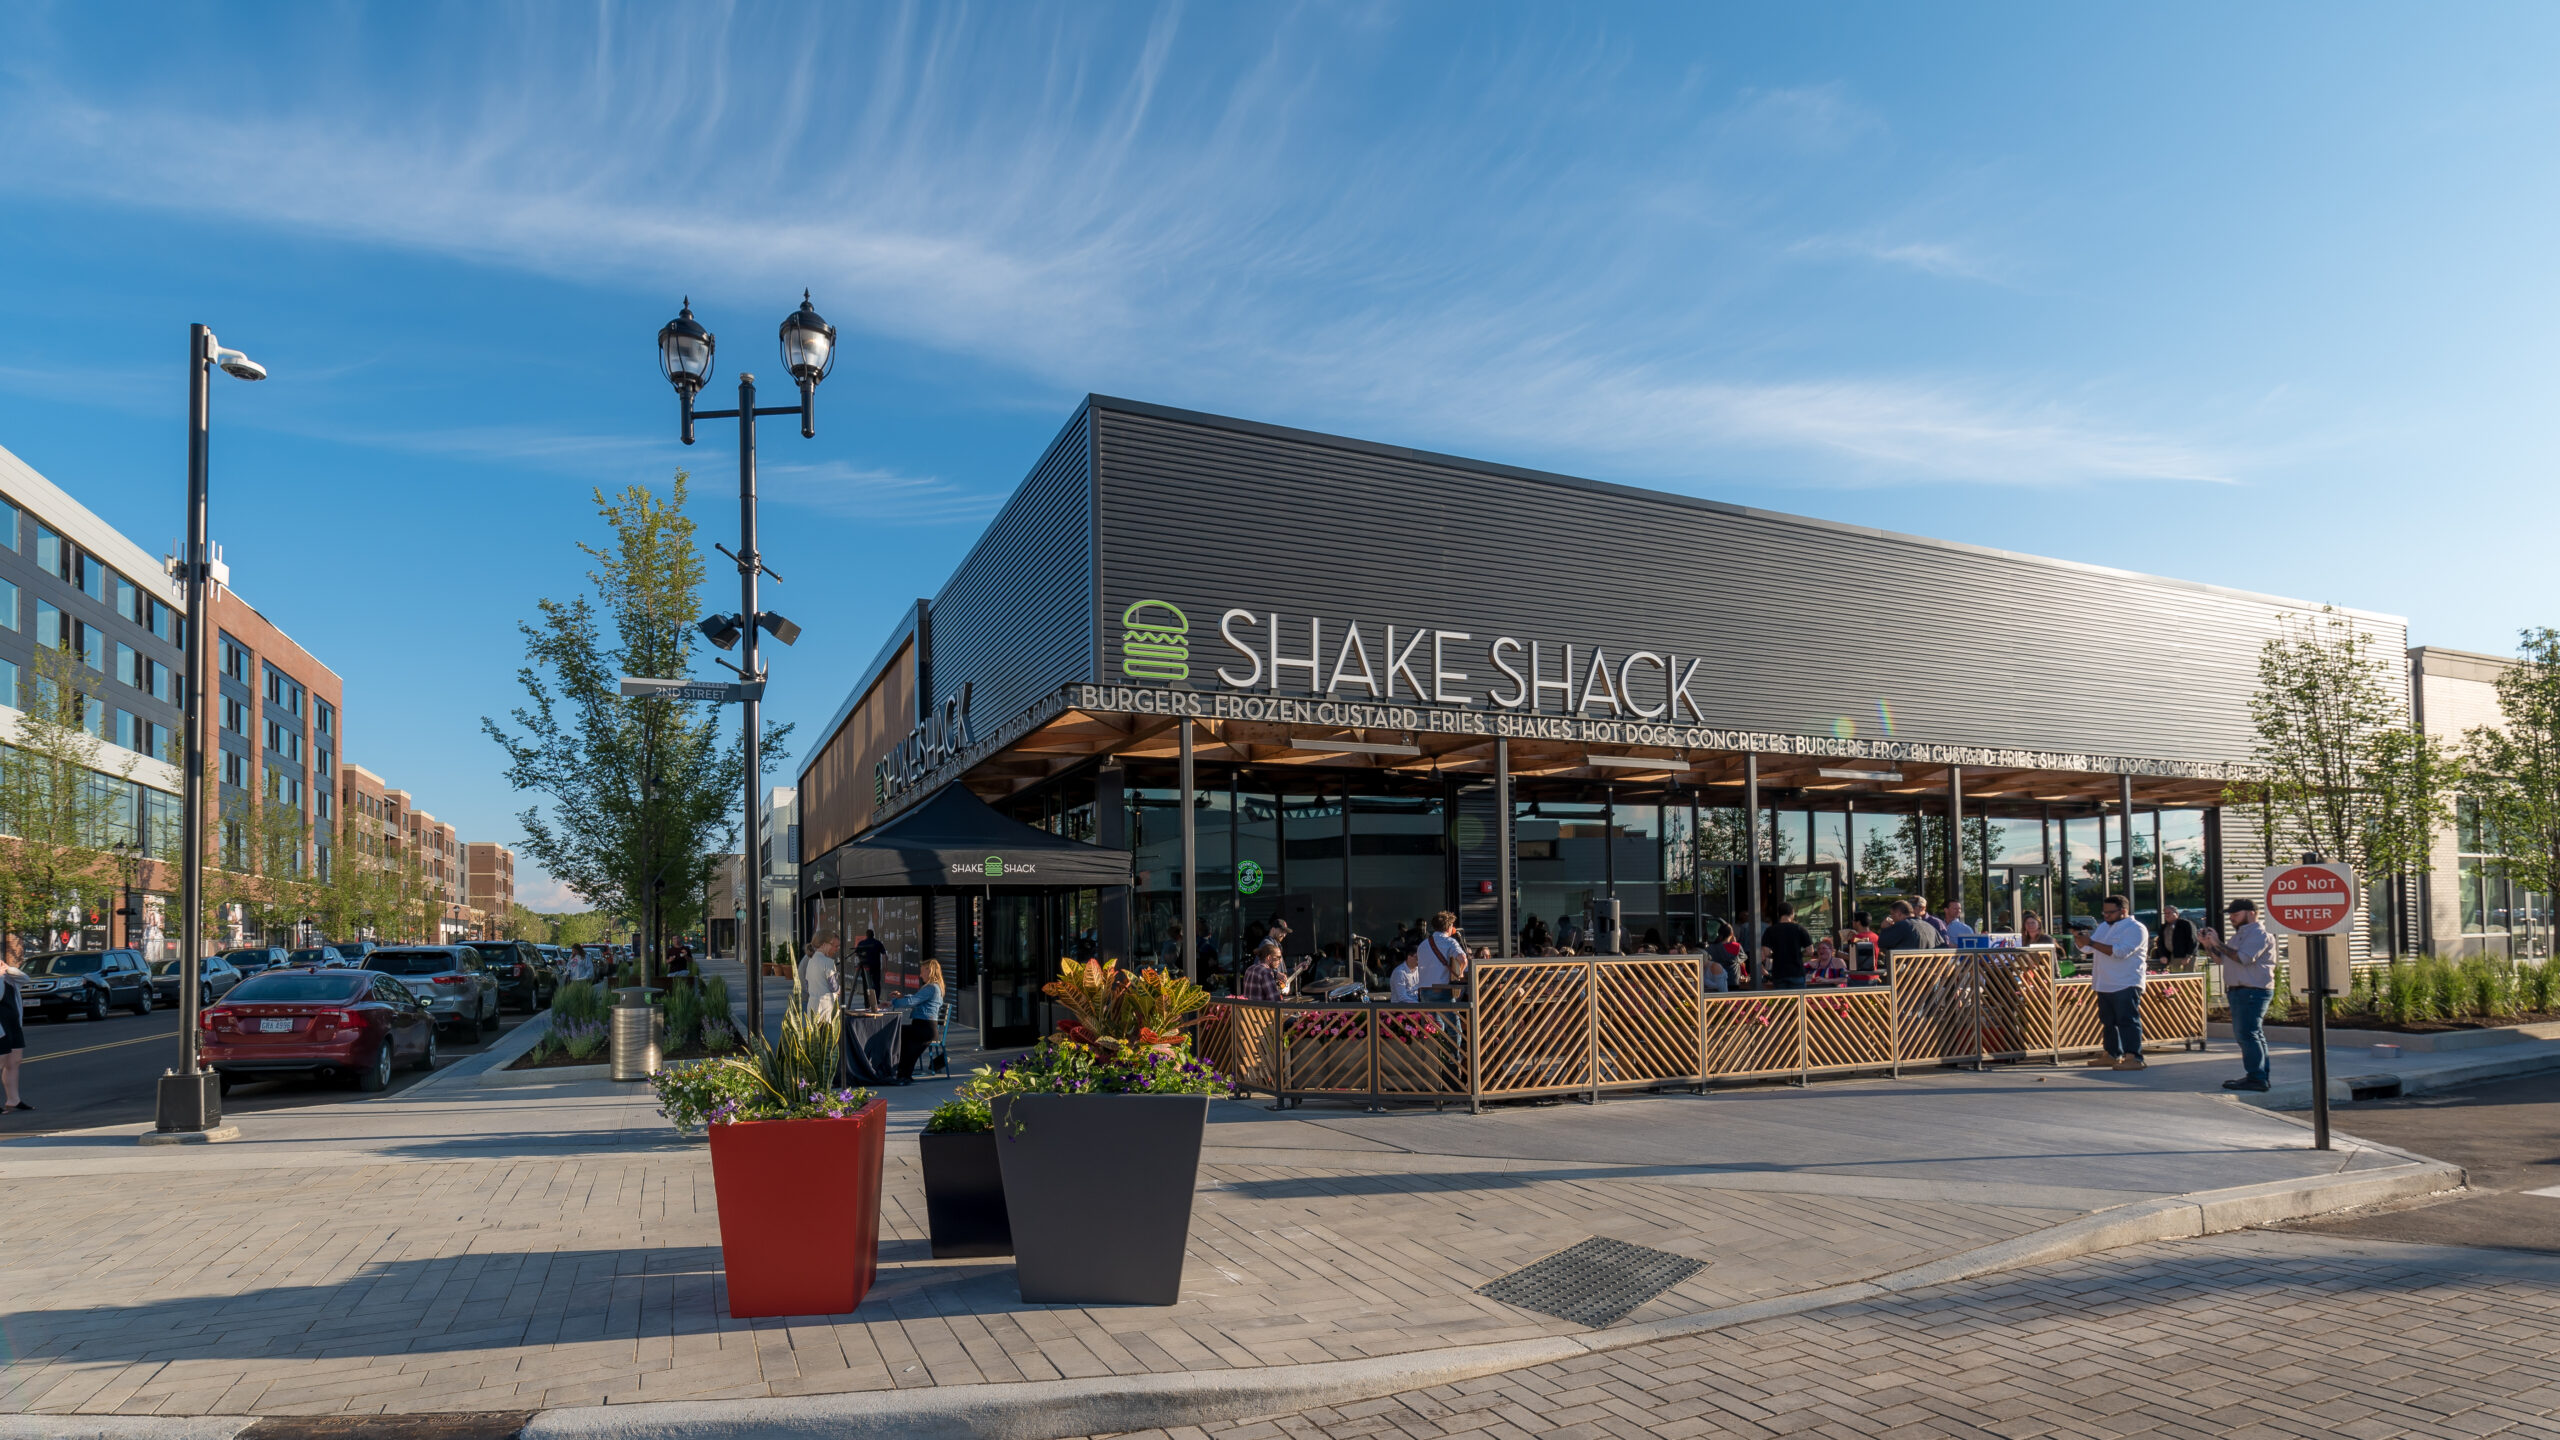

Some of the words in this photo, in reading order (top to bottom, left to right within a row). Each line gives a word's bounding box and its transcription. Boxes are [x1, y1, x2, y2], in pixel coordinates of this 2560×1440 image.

[1217, 608, 1472, 703] SHAKE
[1487, 636, 1705, 721] SHACK
[655, 687, 680, 698] 2ND
[684, 688, 727, 700] STREET
[998, 710, 1031, 746] BURGERS
[1033, 687, 1063, 722] FLOATS
[1081, 685, 1201, 715] BURGERS
[1215, 695, 1311, 722] FROZEN
[1317, 702, 1417, 730] CUSTARD
[1429, 710, 1485, 734] FRIES
[1497, 715, 1573, 740] SHAKES
[1582, 721, 1624, 742] HOT
[1626, 724, 1677, 746] DOGS
[1687, 728, 1788, 753] CONCRETES
[1796, 736, 1865, 757] BURGERS
[1872, 741, 1929, 761] FROZEN
[1933, 745, 1993, 765] CUSTARD
[2000, 750, 2034, 768] FRIES
[2039, 752, 2088, 771] SHAKES
[2092, 756, 2120, 773] HOT
[882, 728, 919, 801] SHAKE
[919, 682, 973, 774] SHACK
[951, 863, 984, 873] SHAKE
[1003, 863, 1036, 873] SHACK
[2277, 880, 2297, 890] DO
[2307, 878, 2336, 890] NOT
[2284, 908, 2332, 919] ENTER
